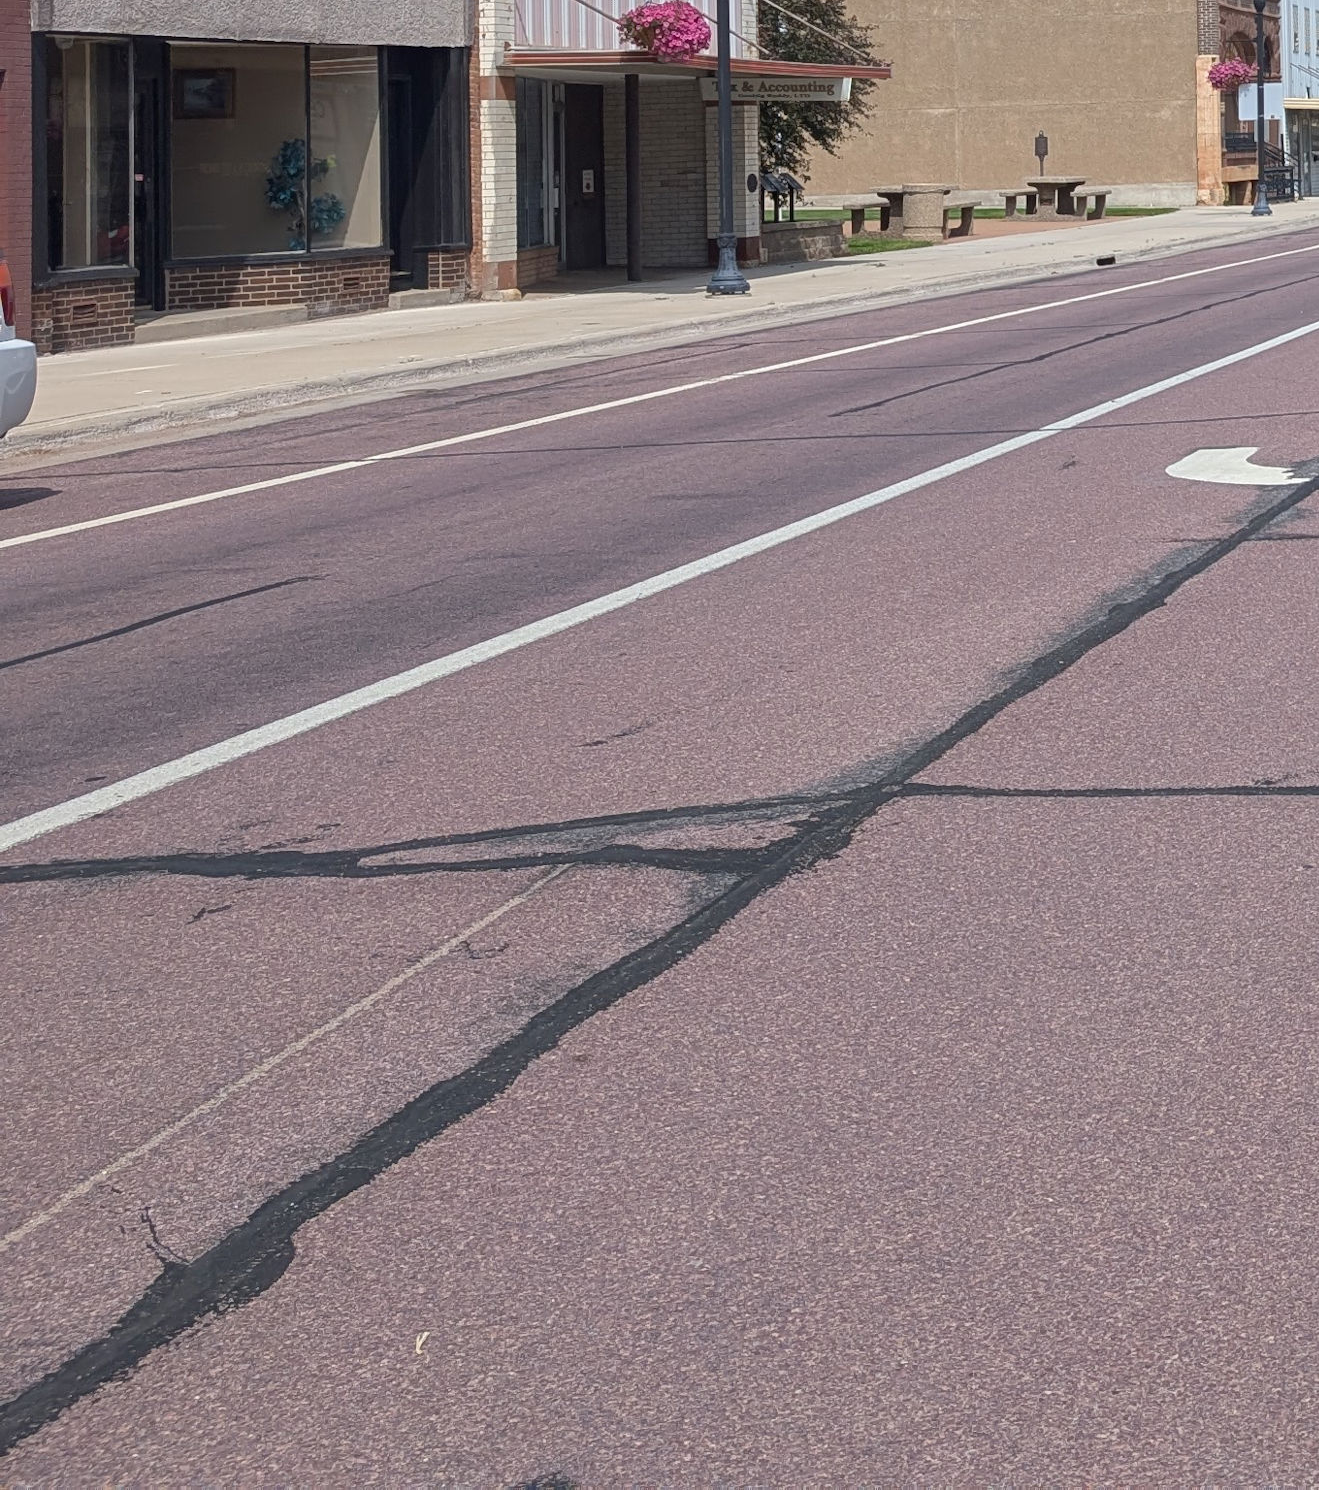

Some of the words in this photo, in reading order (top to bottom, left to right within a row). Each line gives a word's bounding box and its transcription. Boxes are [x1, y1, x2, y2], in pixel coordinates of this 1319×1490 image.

[712, 81, 738, 92] Tx
[739, 81, 754, 92] &
[759, 81, 835, 95] Accounting
